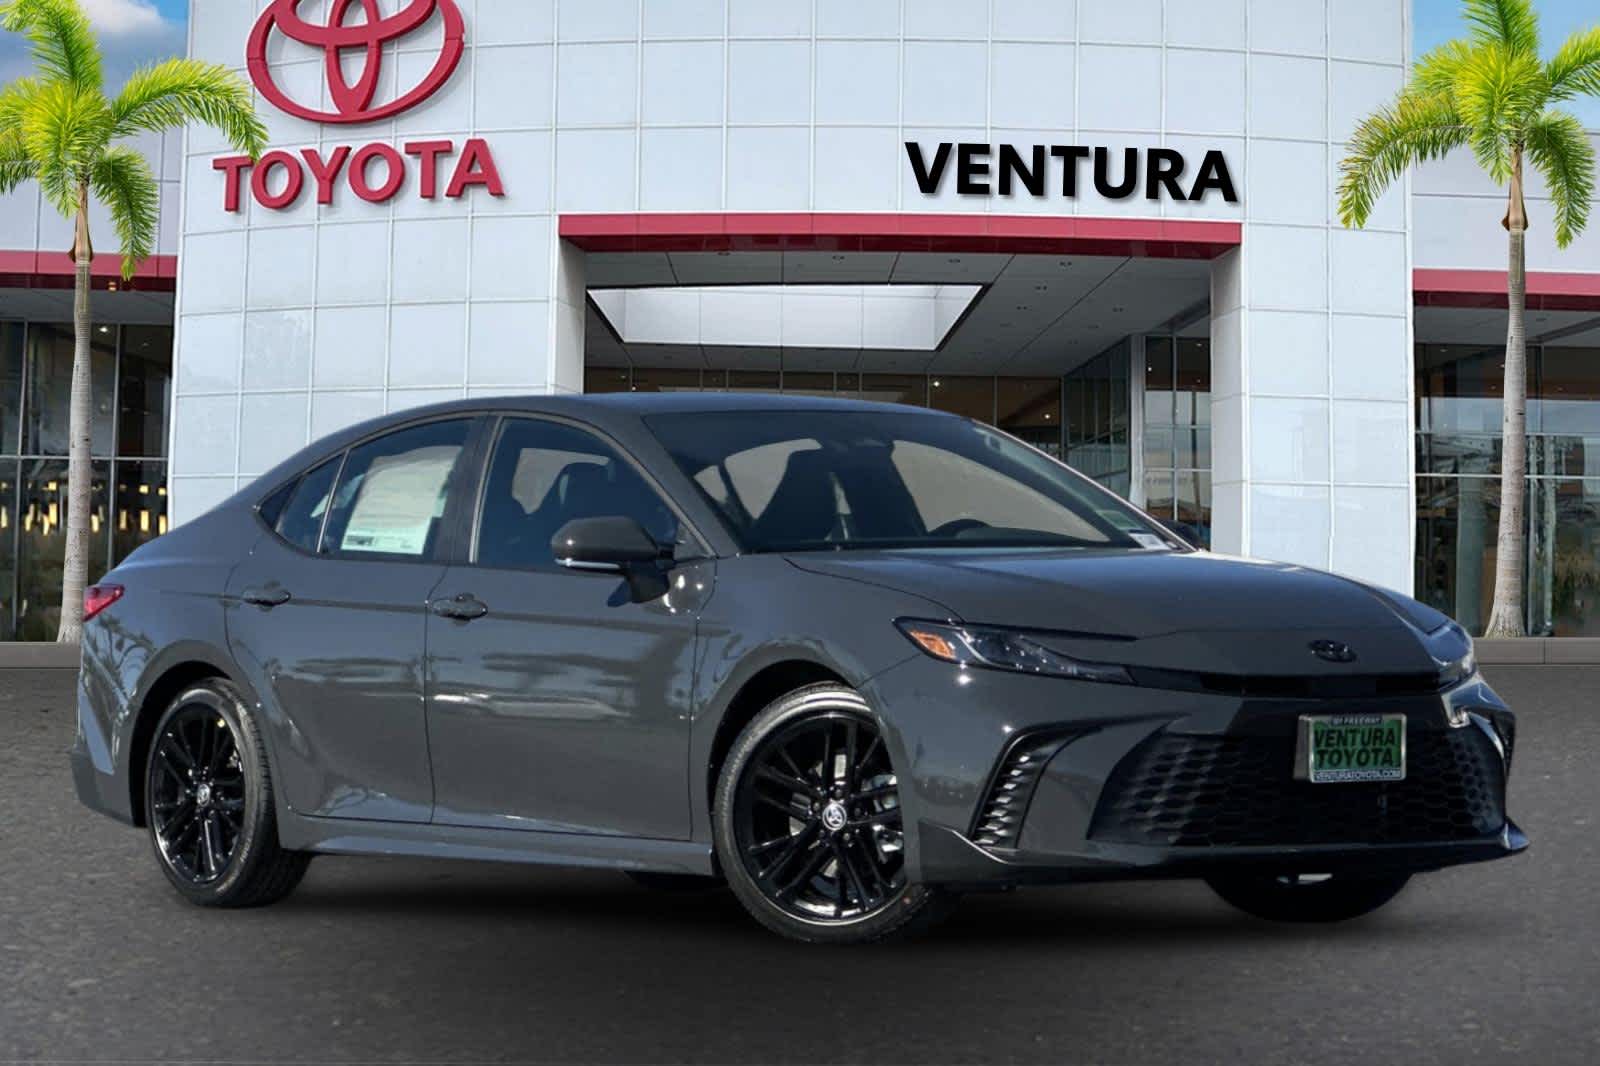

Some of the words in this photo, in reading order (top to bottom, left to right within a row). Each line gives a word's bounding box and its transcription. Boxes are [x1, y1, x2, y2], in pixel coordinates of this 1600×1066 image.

[213, 138, 505, 212] TOYOTA
[904, 141, 1241, 203] VENTURA
[1313, 726, 1396, 748] VENTURA
[1316, 747, 1394, 768] TOYOTA
